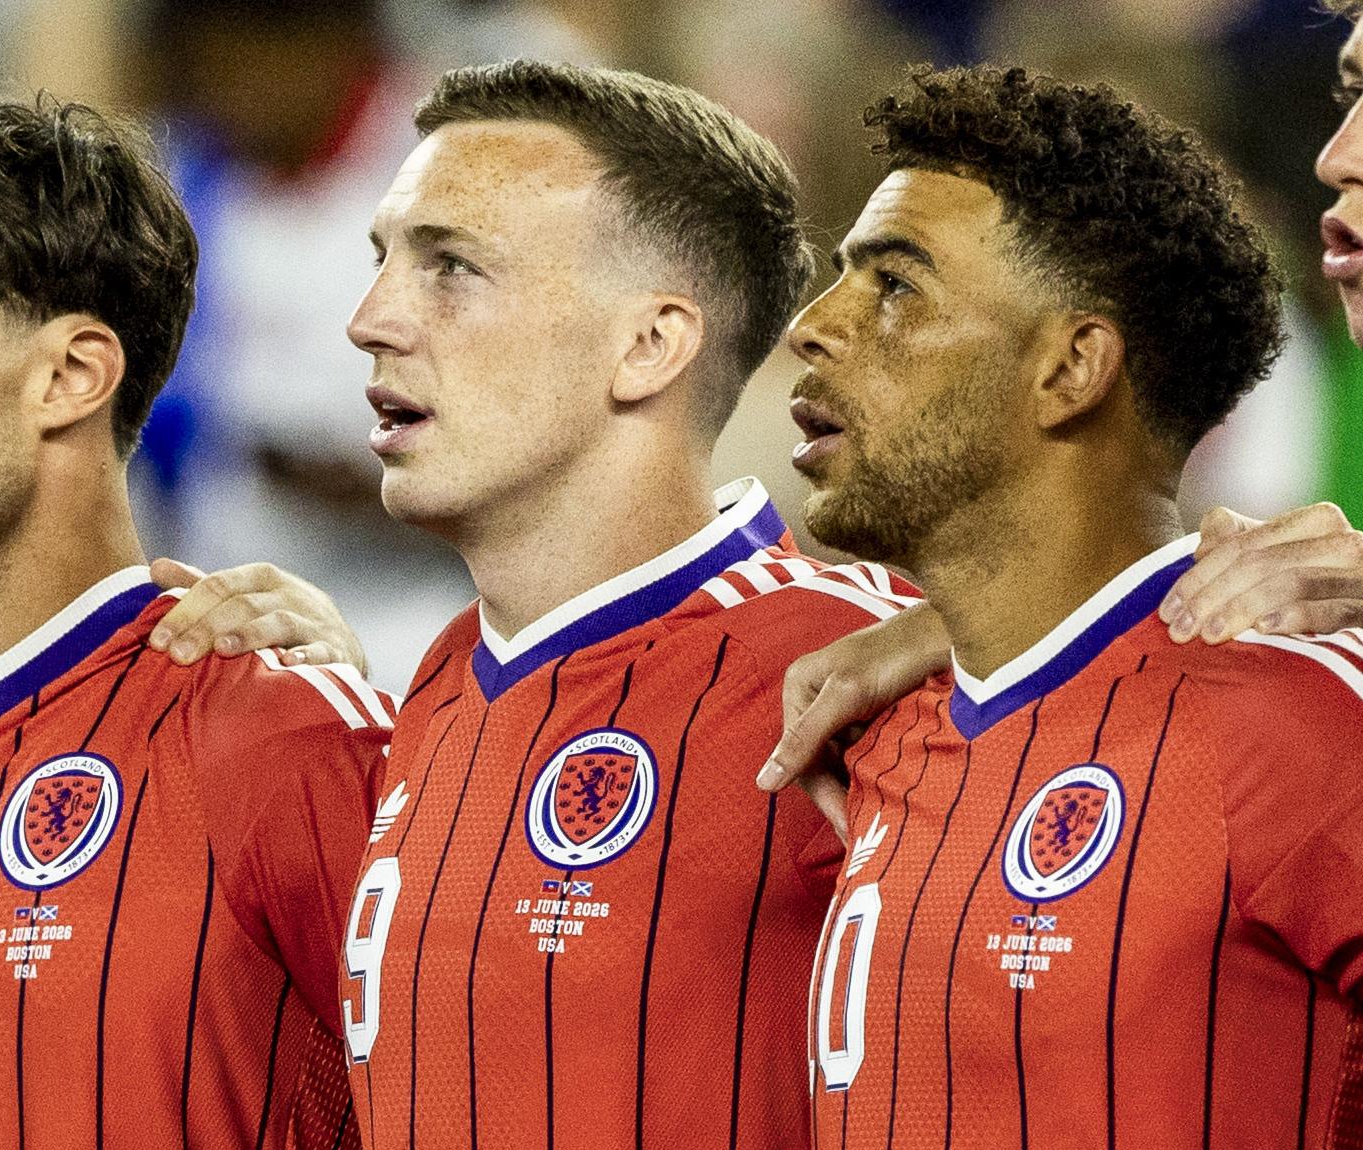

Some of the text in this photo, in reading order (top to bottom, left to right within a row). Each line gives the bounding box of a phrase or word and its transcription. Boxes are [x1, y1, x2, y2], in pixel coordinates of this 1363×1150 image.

[575, 735, 634, 752] SCOTLAND
[45, 759, 102, 774] SCOTLAND
[536, 834, 551, 850] EST
[604, 835, 626, 854] 1873
[67, 852, 88, 871] 1873
[515, 898, 610, 918] 13 JUNE 2026
[8, 925, 40, 942] JUNE
[41, 925, 73, 940] 2026
[529, 918, 585, 936] BOSTON
[538, 937, 565, 953] USA
[986, 934, 1073, 952] 13 JUNE 2026
[5, 944, 52, 961] BOSTON
[343, 856, 403, 1072] 9
[1000, 954, 1051, 971] BOSTON
[14, 964, 37, 979] USA
[1009, 973, 1035, 989] USA
